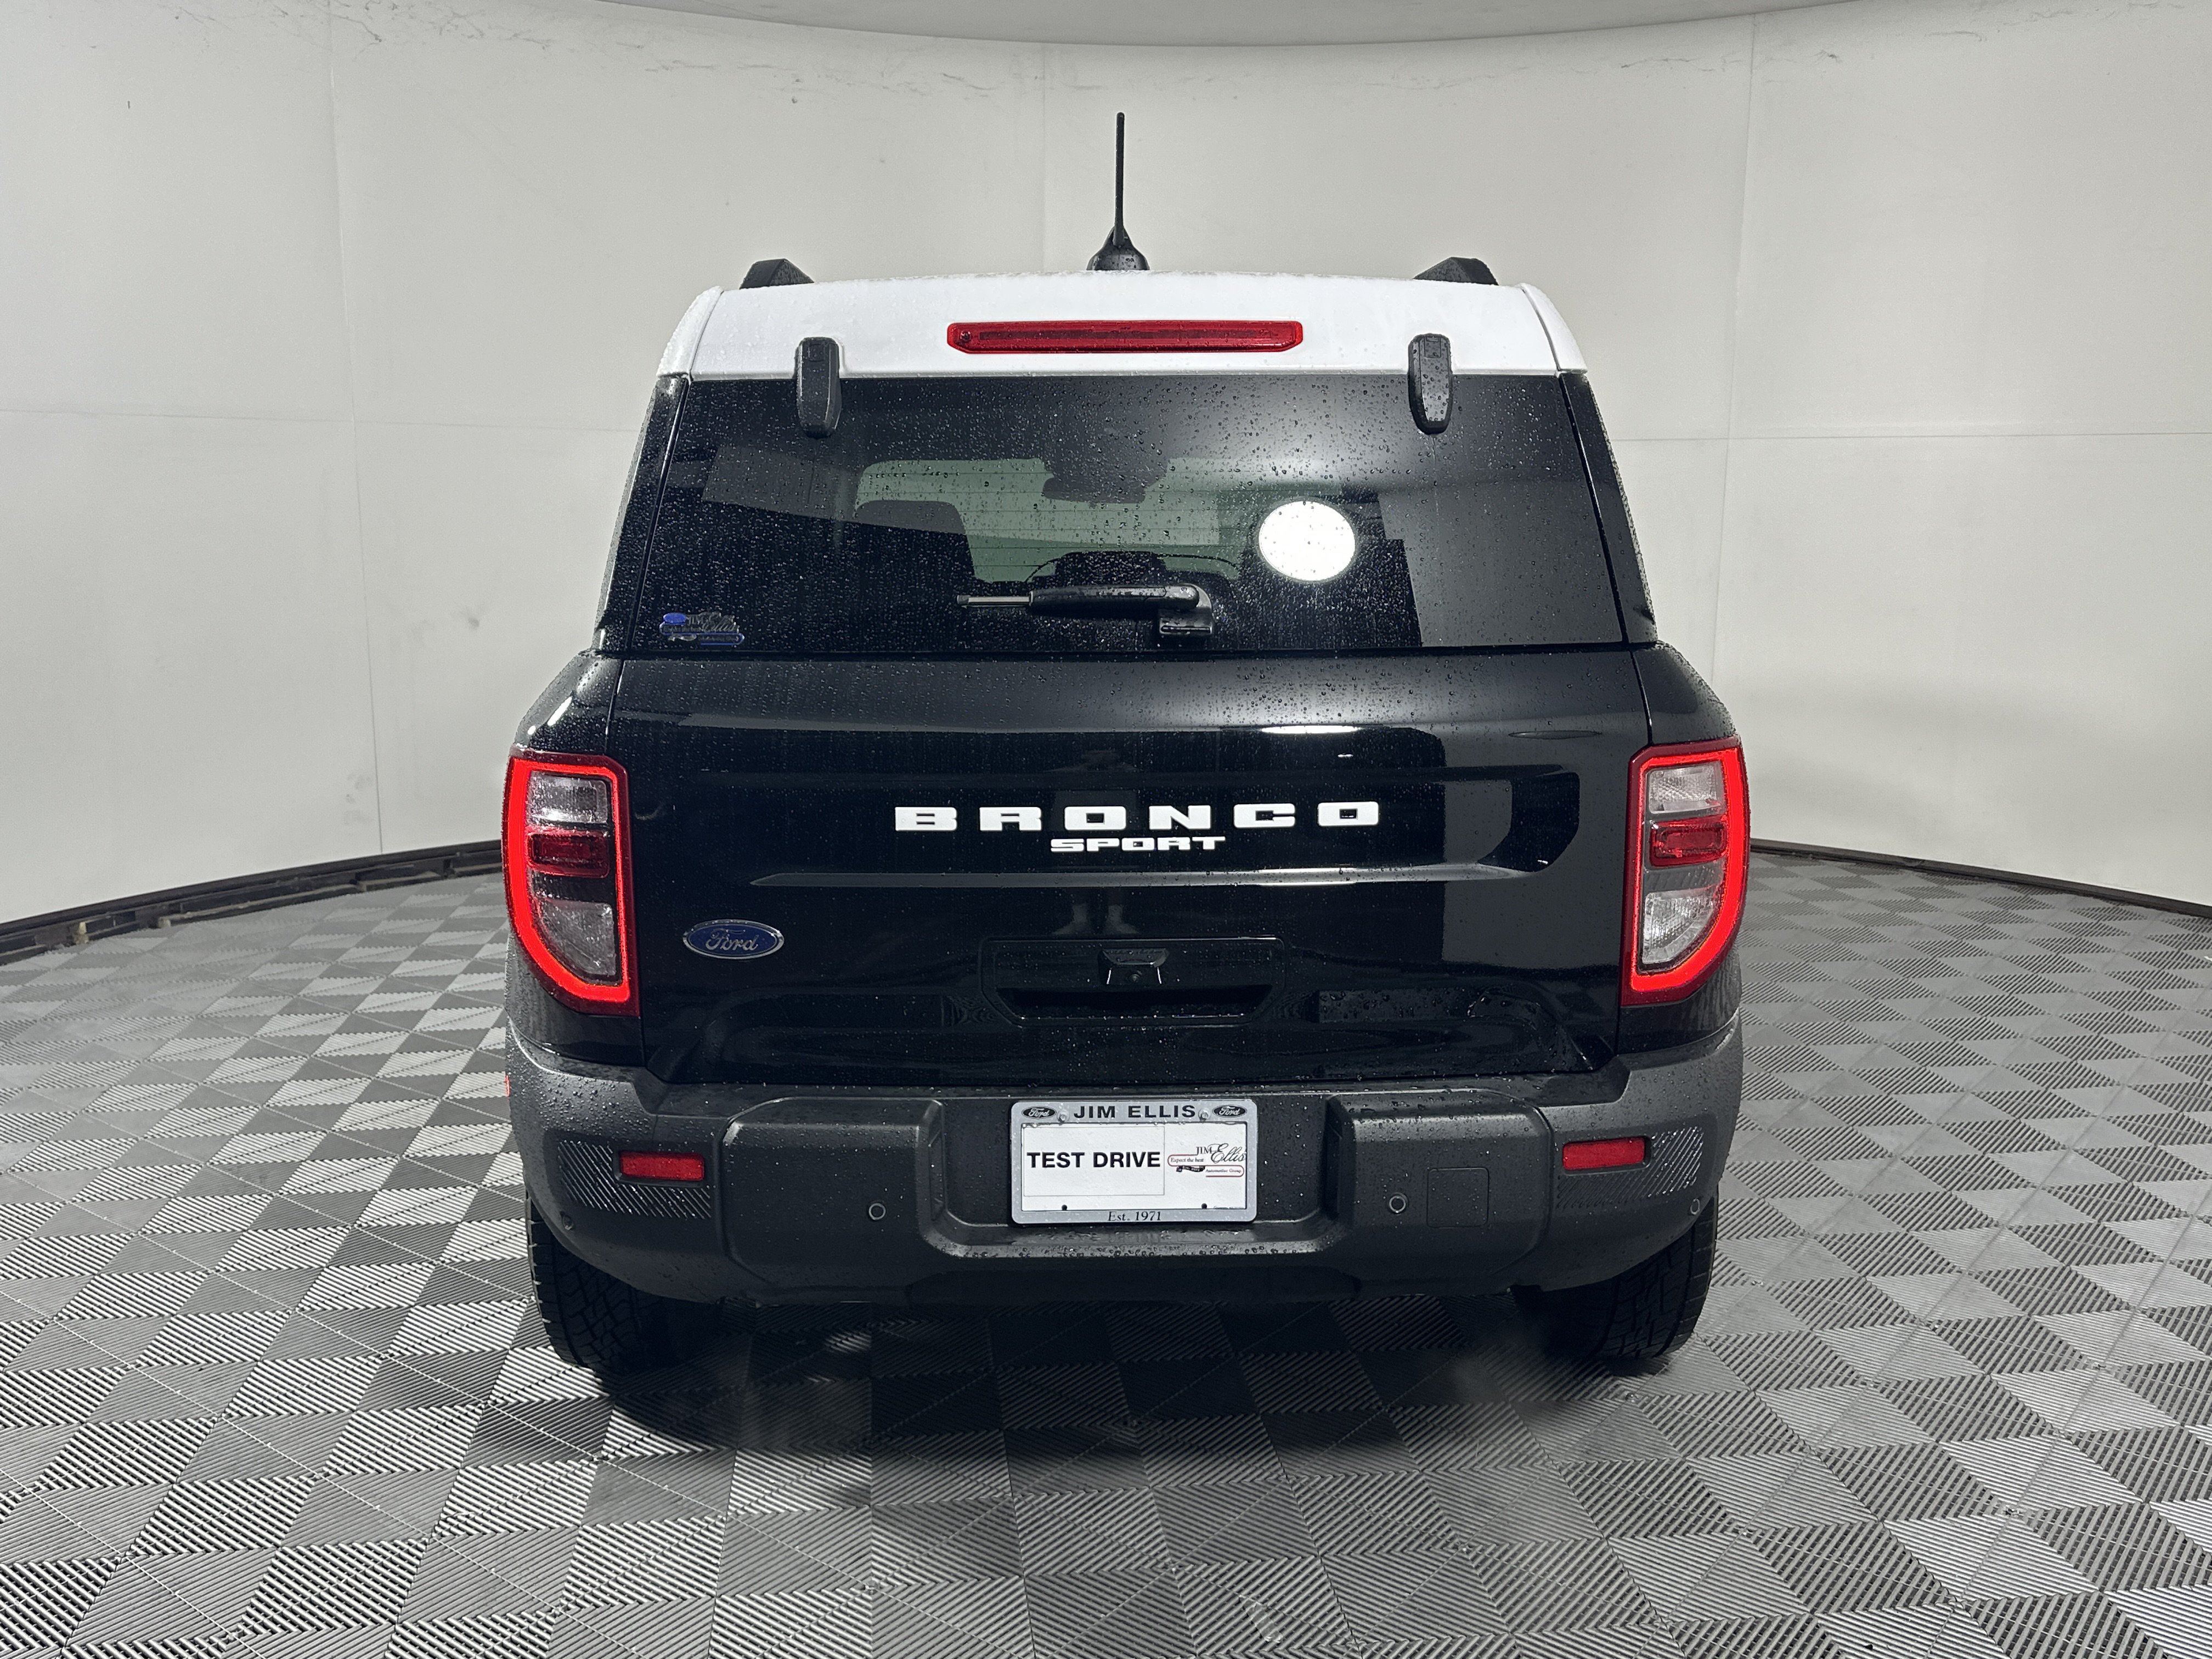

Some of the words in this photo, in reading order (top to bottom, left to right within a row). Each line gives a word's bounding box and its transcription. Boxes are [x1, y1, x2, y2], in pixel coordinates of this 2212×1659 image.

[895, 802, 1379, 831] BRONCO
[1051, 836, 1226, 853] SPORT
[705, 928, 759, 951] Ford
[1028, 1107, 1051, 1118] Ford
[1074, 1105, 1116, 1119] JIM
[1128, 1105, 1195, 1118] ELLIS
[1218, 1106, 1242, 1116] Ford
[1027, 1152, 1085, 1169] TEST
[1093, 1151, 1160, 1168] DRIVE
[1196, 1146, 1212, 1155] JIM
[1207, 1143, 1246, 1164] Ellis
[1108, 1211, 1131, 1222] Est.
[1135, 1211, 1161, 1221] 1971
